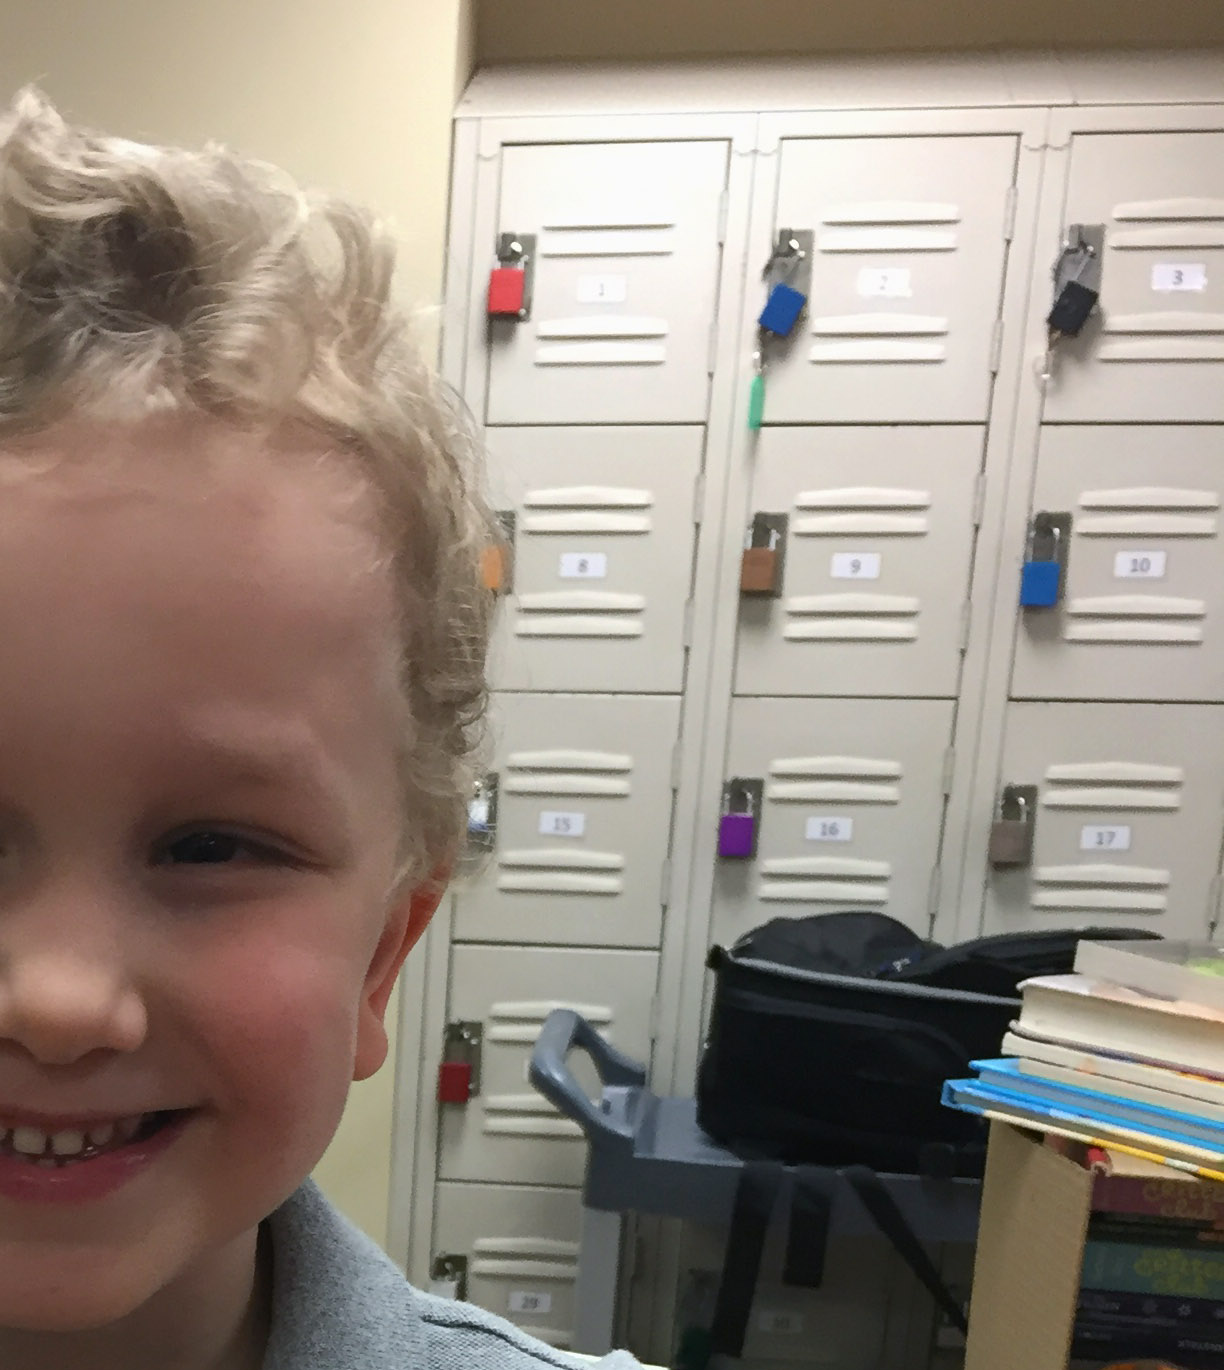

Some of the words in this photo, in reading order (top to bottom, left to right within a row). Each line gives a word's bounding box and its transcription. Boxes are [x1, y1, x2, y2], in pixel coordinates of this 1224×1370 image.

[1129, 556, 1152, 573] 10
[553, 816, 571, 833] 15
[819, 820, 840, 838] 16
[1095, 830, 1116, 847] 17
